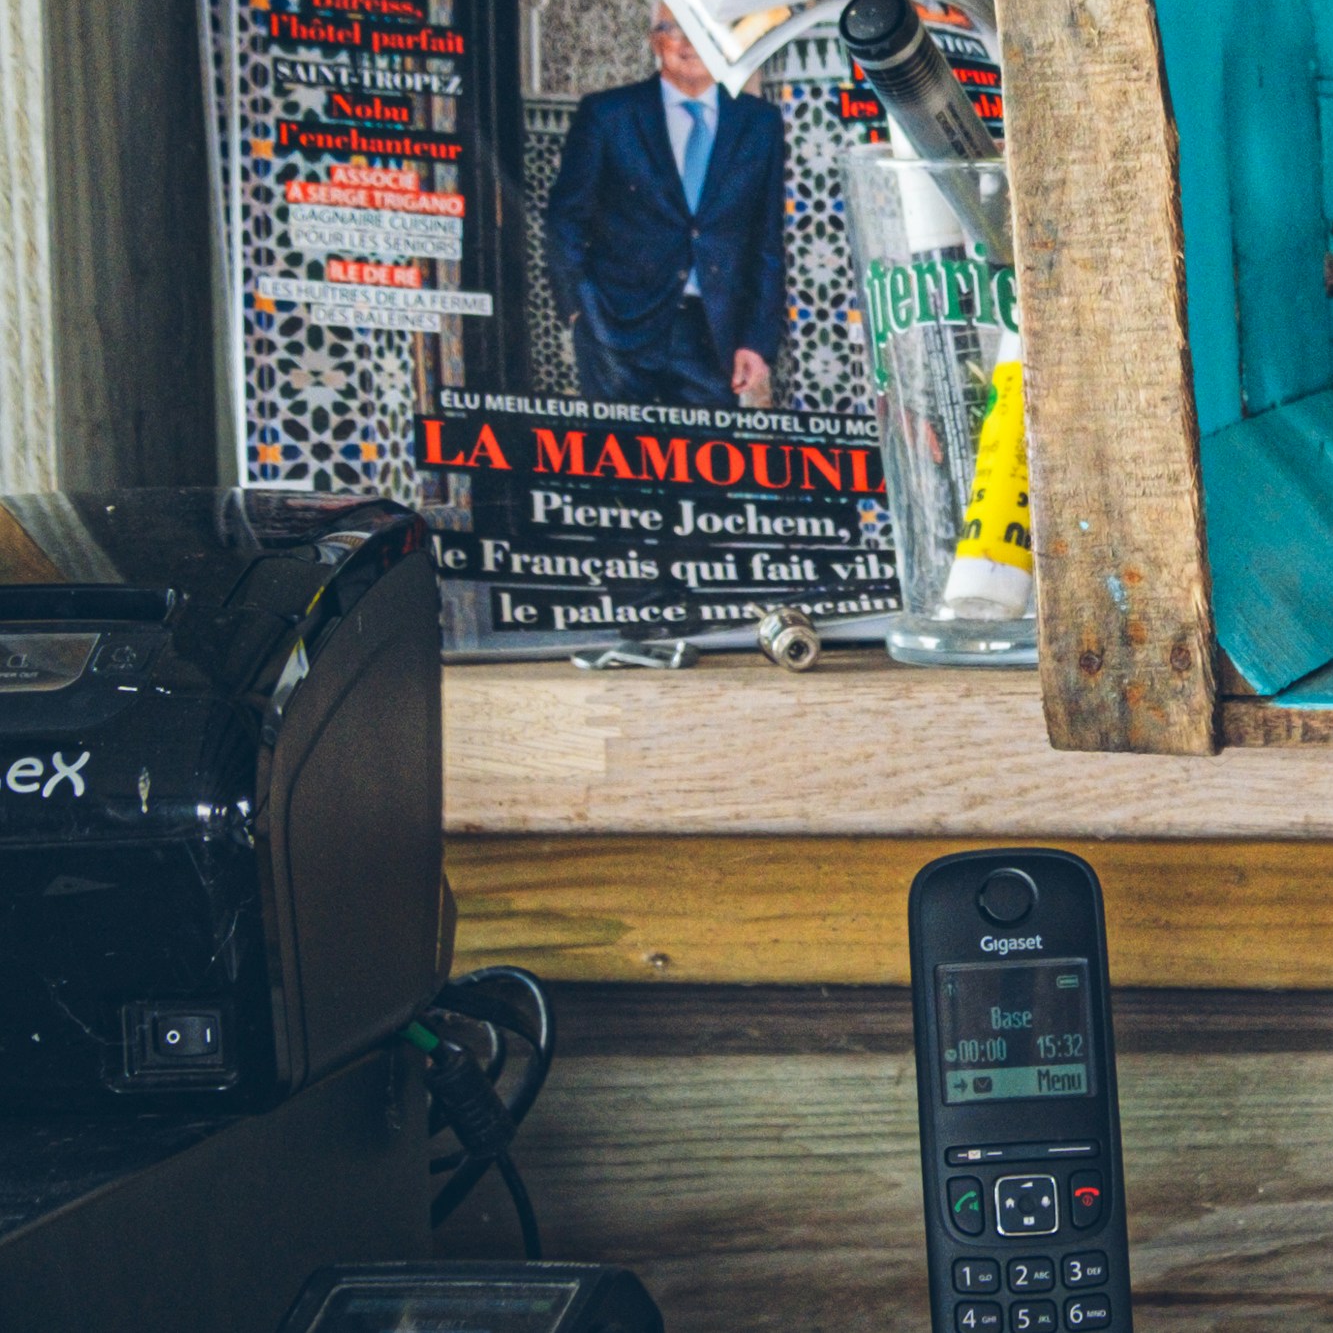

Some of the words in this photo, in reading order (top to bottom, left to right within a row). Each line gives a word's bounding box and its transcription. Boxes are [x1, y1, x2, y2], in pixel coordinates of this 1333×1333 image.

[269, 12, 362, 46] l'hôtel
[370, 27, 466, 55] parfait
[276, 61, 464, 96] SAINT-TROPEZ
[330, 92, 411, 123] Nobu
[278, 121, 463, 161] l'enchanteur
[307, 185, 368, 208] SERGE
[373, 190, 464, 214] TRIGANO
[292, 206, 383, 229] GAGNAIRE
[389, 215, 462, 234] CUISINE
[293, 228, 343, 246] POUR
[349, 232, 379, 250] LES
[363, 263, 389, 284] DE
[393, 265, 421, 286] RÉ
[259, 279, 292, 299] LES
[296, 280, 370, 306] HUÎTRES
[374, 287, 397, 307] DE
[401, 289, 425, 309] LA
[429, 292, 491, 314] FERME
[315, 305, 348, 324] DES
[351, 307, 439, 329] BALEINES
[863, 241, 1019, 394] perrie
[440, 388, 480, 411] ÉLU
[484, 394, 590, 419] MEILLEUR
[592, 401, 711, 428] DIRECTEUR
[714, 408, 805, 435] D'HÔTEL
[808, 414, 841, 436] DU
[844, 418, 880, 439] MO
[421, 419, 513, 471] LA
[531, 426, 887, 495] MAMOUNI
[529, 489, 664, 533] Pierre
[672, 499, 853, 545] Jochem,
[479, 537, 660, 590] Français
[669, 550, 740, 590] qui
[749, 551, 819, 582] fait
[829, 551, 898, 582] vib
[498, 592, 538, 626] le
[550, 593, 688, 632] palace
[979, 933, 1044, 956] Gigaset
[990, 1006, 1034, 1030] Base
[958, 1037, 1007, 1064] 00:00
[1036, 1033, 1085, 1060] 15:32
[1036, 1068, 1083, 1093] Menu
[961, 1266, 972, 1287] 1
[1014, 1264, 1030, 1287] 2
[1069, 1260, 1083, 1282] 3
[961, 1308, 977, 1329] 4
[1018, 1308, 1031, 1330] 5
[1069, 1303, 1084, 1325] 6
